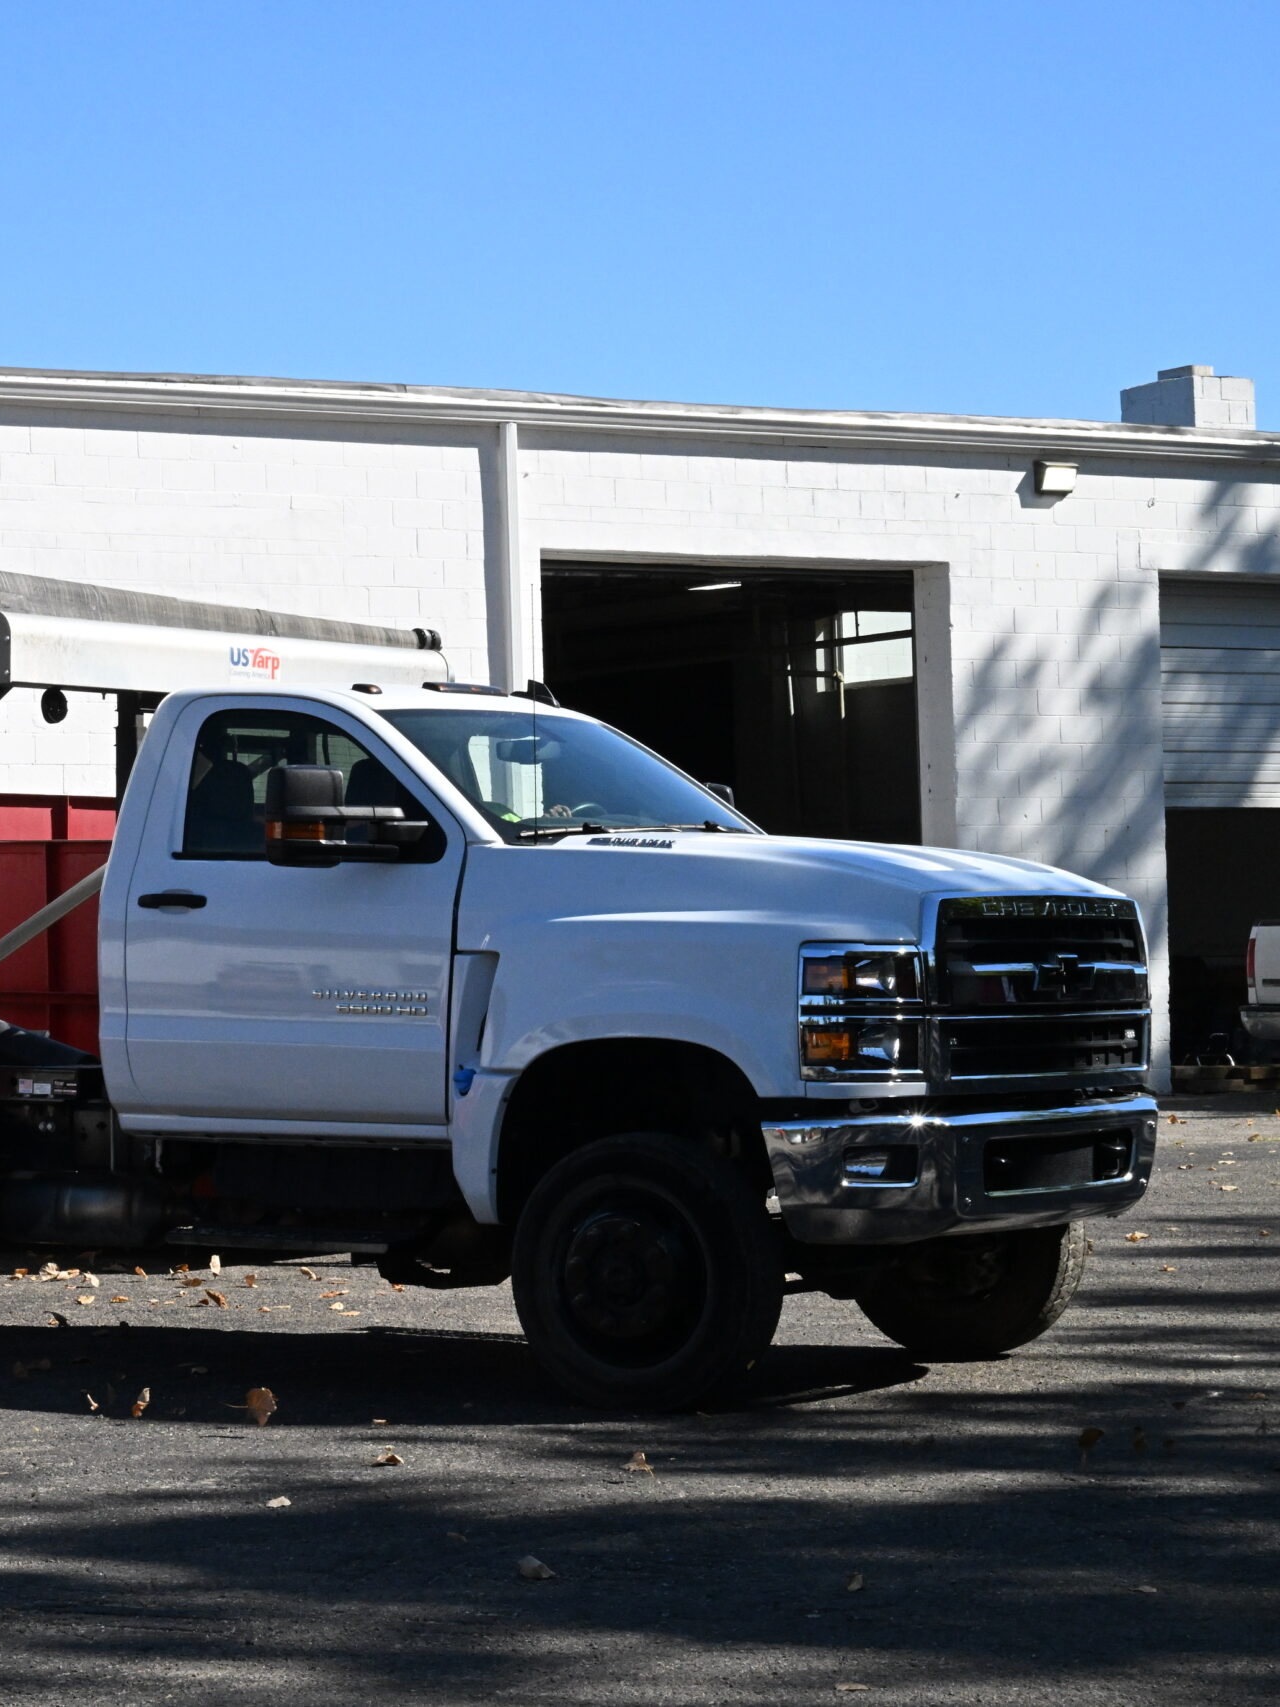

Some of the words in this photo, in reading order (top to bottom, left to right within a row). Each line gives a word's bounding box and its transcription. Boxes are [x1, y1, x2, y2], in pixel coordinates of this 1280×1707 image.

[610, 838, 675, 848] DURAMAX
[981, 901, 1119, 917] CHEVROLET
[312, 989, 427, 1002] SILVERADO
